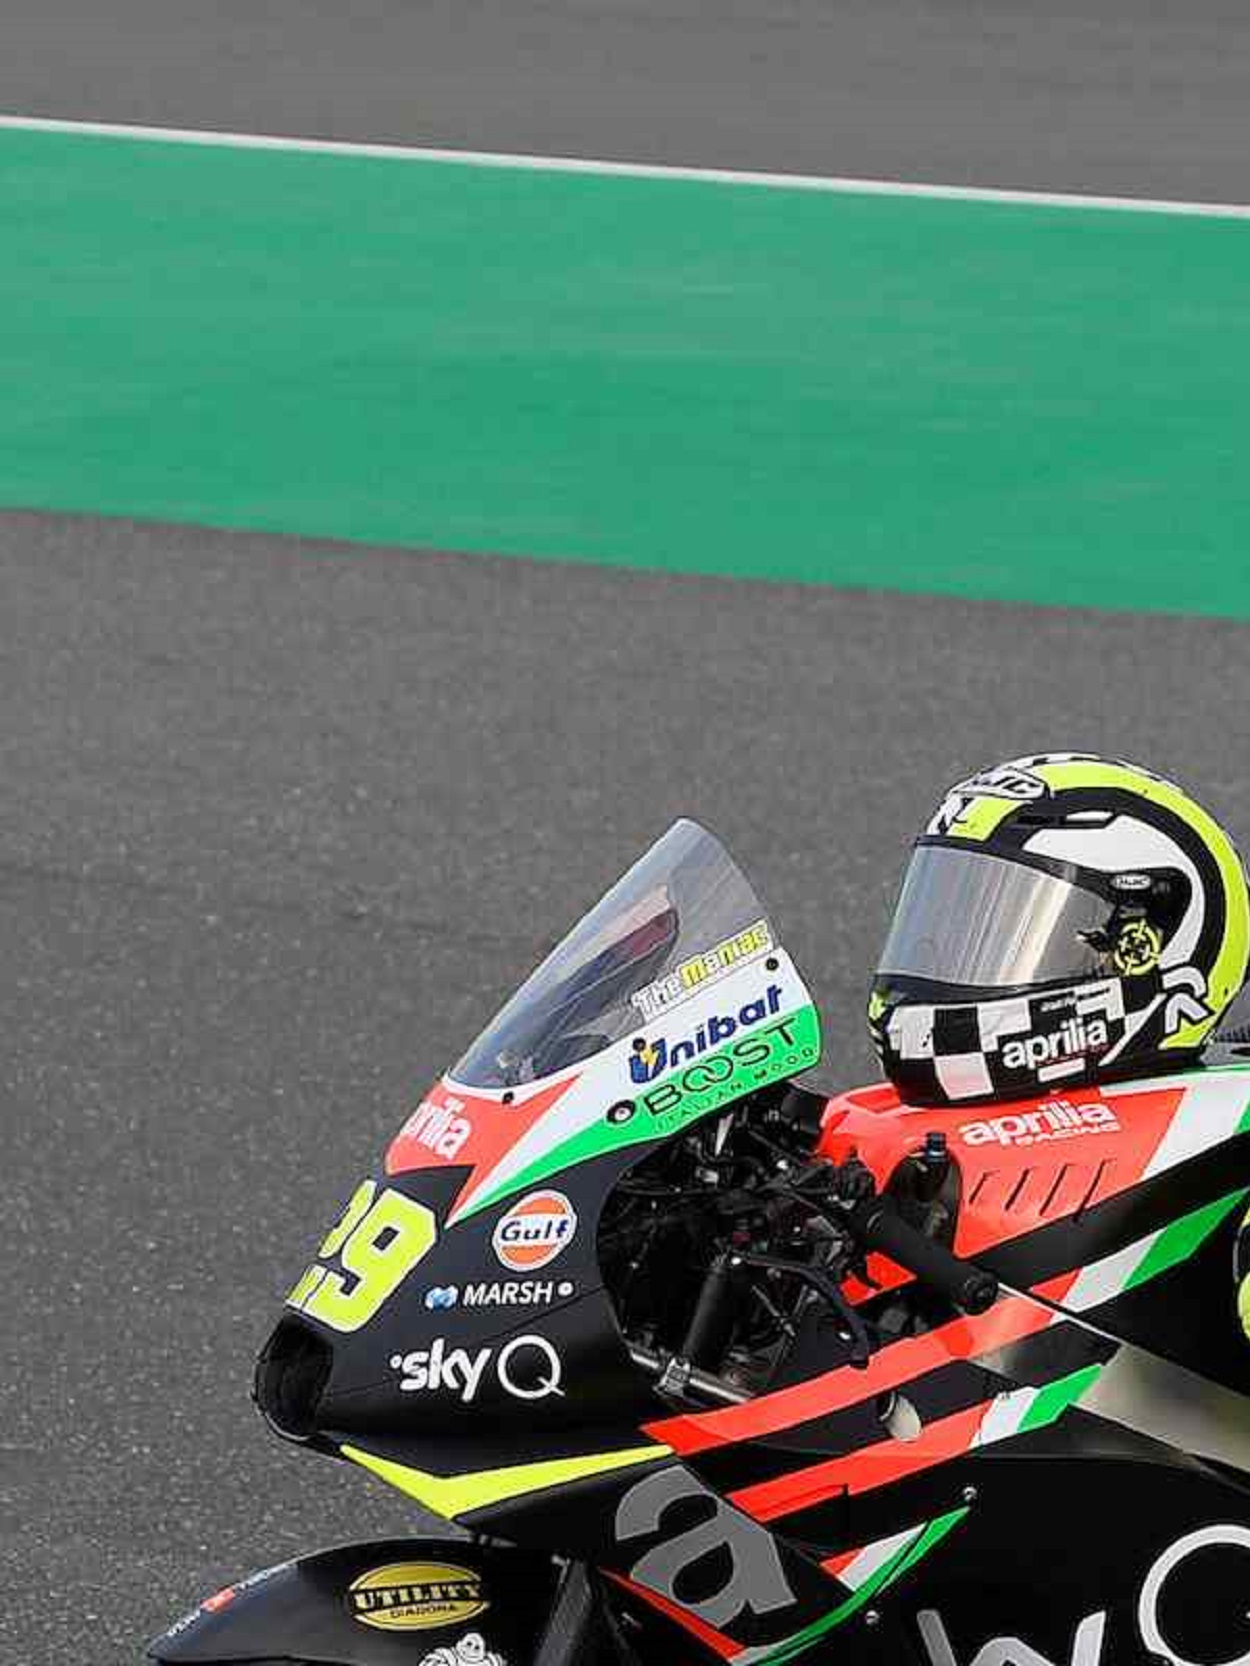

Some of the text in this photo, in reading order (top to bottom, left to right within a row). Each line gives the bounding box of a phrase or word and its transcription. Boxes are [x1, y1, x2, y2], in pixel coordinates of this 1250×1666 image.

[629, 984, 783, 1084] Unibat
[1001, 1016, 1108, 1070] aprilia
[643, 1016, 796, 1116] BOOST
[958, 1097, 1117, 1146] aprilia
[500, 1218, 569, 1242] Gulf
[462, 1281, 553, 1306] MARSH
[399, 1334, 566, 1403] sky Q
[354, 1584, 480, 1610] UTILITY
